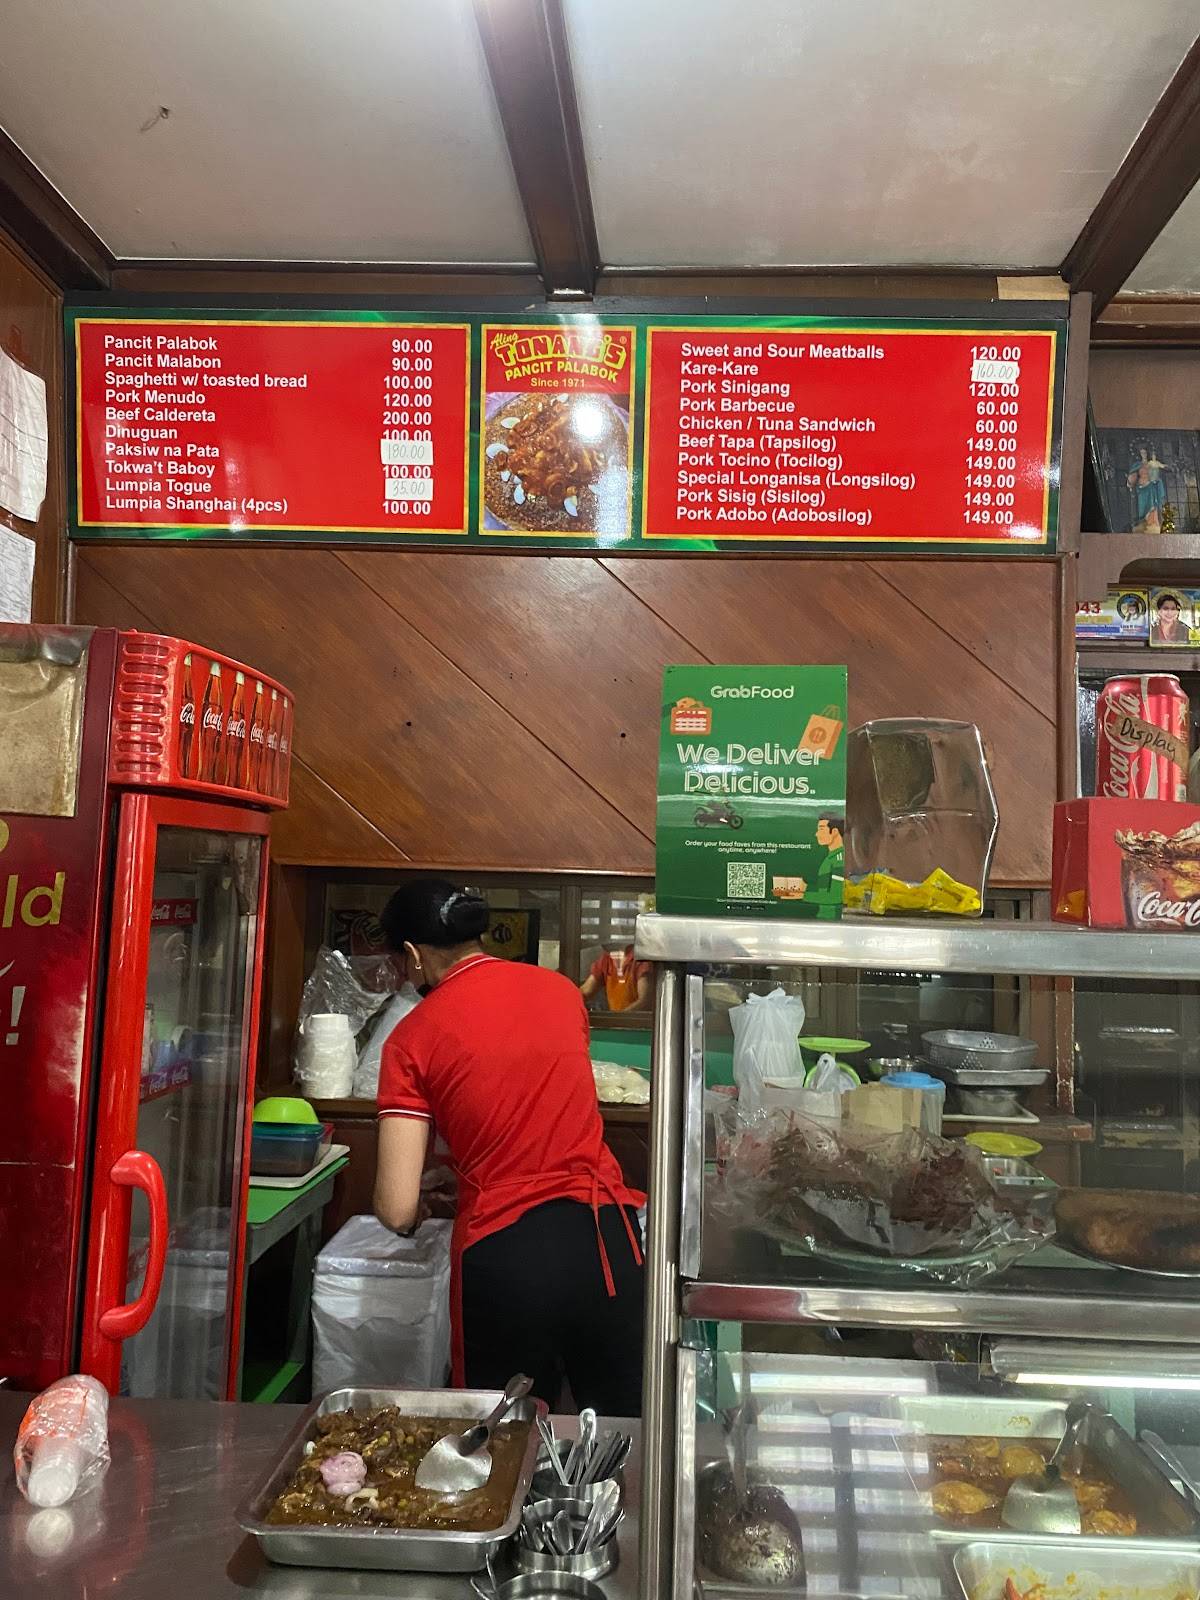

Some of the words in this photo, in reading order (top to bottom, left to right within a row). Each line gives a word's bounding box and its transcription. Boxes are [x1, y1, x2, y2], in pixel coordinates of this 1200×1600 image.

[104, 336, 152, 349] Pancit
[156, 336, 217, 349] Palabok
[391, 339, 432, 353] 90.00
[490, 332, 519, 349] Aling
[681, 343, 729, 357] Sweet
[733, 344, 762, 357] and
[767, 344, 805, 357] Sour
[809, 345, 884, 358] Meatballs
[970, 347, 1021, 362] 120.00
[105, 354, 152, 367] Pancit
[156, 354, 221, 368] Malabon
[391, 358, 432, 371] 90.00
[680, 361, 758, 375] Kare-Kare
[505, 360, 553, 381] PANCIT
[557, 361, 618, 383] PALABOK
[105, 371, 176, 388] Spaghetti
[181, 373, 198, 385] w/
[202, 374, 259, 386] toasted
[264, 374, 306, 387] bread
[383, 376, 432, 389] 100.00
[531, 378, 559, 387] Since
[562, 378, 585, 387] 1971
[680, 380, 716, 393] Pork
[720, 380, 789, 397] Sinigang
[968, 383, 1019, 397] 120.00
[105, 389, 140, 402] Pork
[144, 390, 205, 403] Menudo
[383, 394, 432, 407] 120.00
[679, 398, 715, 411] Pork
[720, 398, 795, 412] Barbecue
[976, 402, 1018, 415] 60.00
[105, 407, 140, 421] Beef
[143, 408, 215, 421] Caldereta
[382, 412, 431, 425] 200.00
[679, 416, 742, 429] Chicken
[746, 417, 752, 429] /
[756, 417, 793, 430] Tuna
[798, 417, 875, 431] Sandwich
[975, 420, 1017, 433] 60.00
[105, 424, 177, 441] Dinuguan
[105, 442, 159, 456] Paksiw
[163, 447, 181, 456] na
[186, 444, 219, 457] Pata
[678, 434, 714, 447] Beef
[718, 435, 754, 451] Tapa
[759, 435, 836, 452] (Tapsilog)
[966, 438, 1016, 451] 149.00
[678, 452, 713, 465] Pork
[718, 453, 770, 466] Tocino
[775, 454, 842, 470] (Tocilog)
[965, 456, 1016, 470] 149.00
[105, 460, 163, 474] Tokwa't
[167, 461, 215, 478] Baboy
[382, 465, 432, 478] 100.00
[106, 478, 161, 494] Lumpia
[165, 479, 211, 495] Togue
[677, 470, 734, 487] Special
[739, 471, 820, 488] Longanisa
[825, 472, 915, 489] (Longsilog)
[964, 474, 1015, 488] 149.00
[106, 496, 161, 512] Lumpia
[165, 496, 236, 513] Shanghai
[240, 498, 287, 514] (4pcs)
[677, 489, 712, 502] Pork
[717, 489, 755, 506] Sisig
[760, 490, 825, 507] (Sisilog)
[964, 492, 1014, 506] 149.00
[382, 501, 430, 514] 100.00
[676, 507, 712, 520] Pork
[715, 507, 767, 520] Adobo
[771, 508, 872, 525] (Adobosilog)
[963, 511, 1013, 524] 149.00
[711, 685, 795, 699] GrabFood
[1120, 717, 1176, 761] Display
[677, 743, 720, 765] We
[727, 742, 826, 766] Deliver
[684, 770, 816, 795] Delicious.
[778, 842, 812, 850] restaurant
